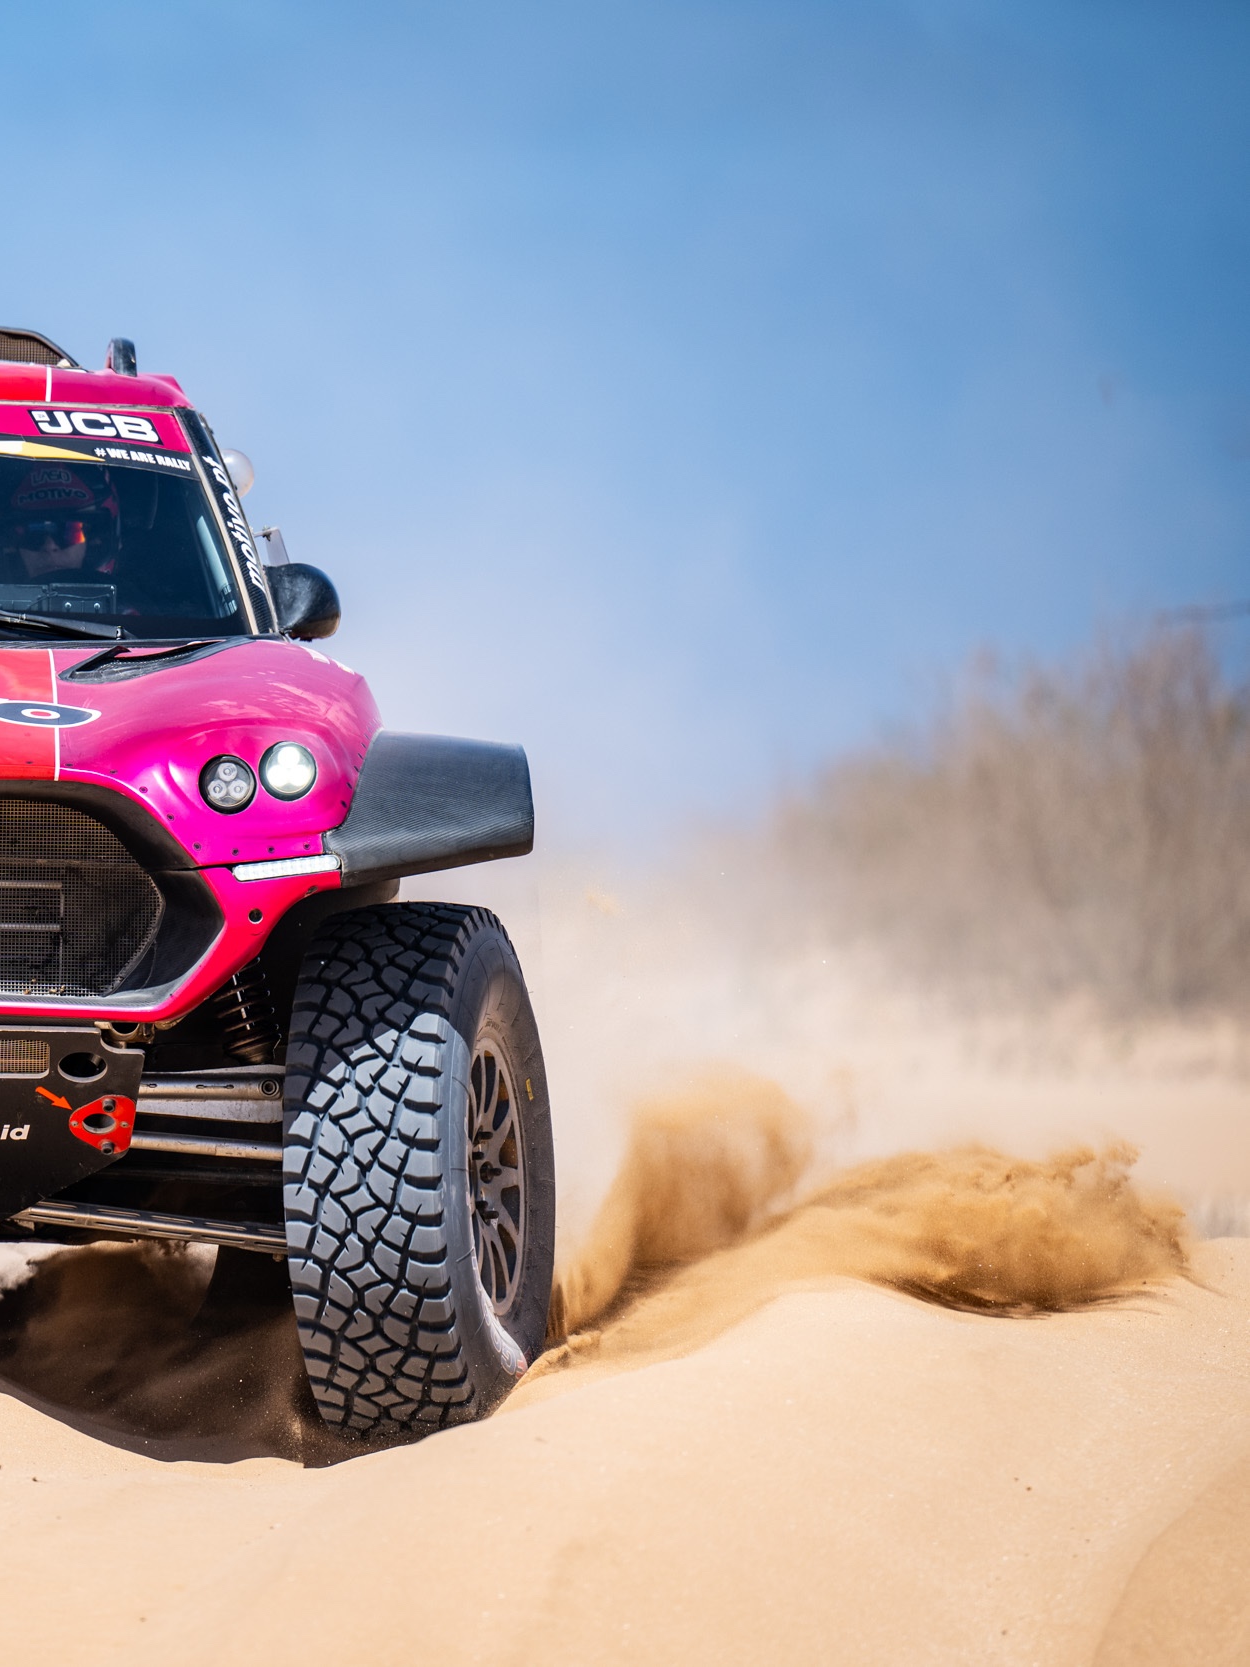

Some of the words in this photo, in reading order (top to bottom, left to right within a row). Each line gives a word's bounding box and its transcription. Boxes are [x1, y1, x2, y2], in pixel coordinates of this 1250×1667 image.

[31, 411, 159, 442] JCB
[130, 450, 156, 464] ARE
[155, 455, 191, 471] RALLY
[18, 486, 89, 506] MOTIVO
